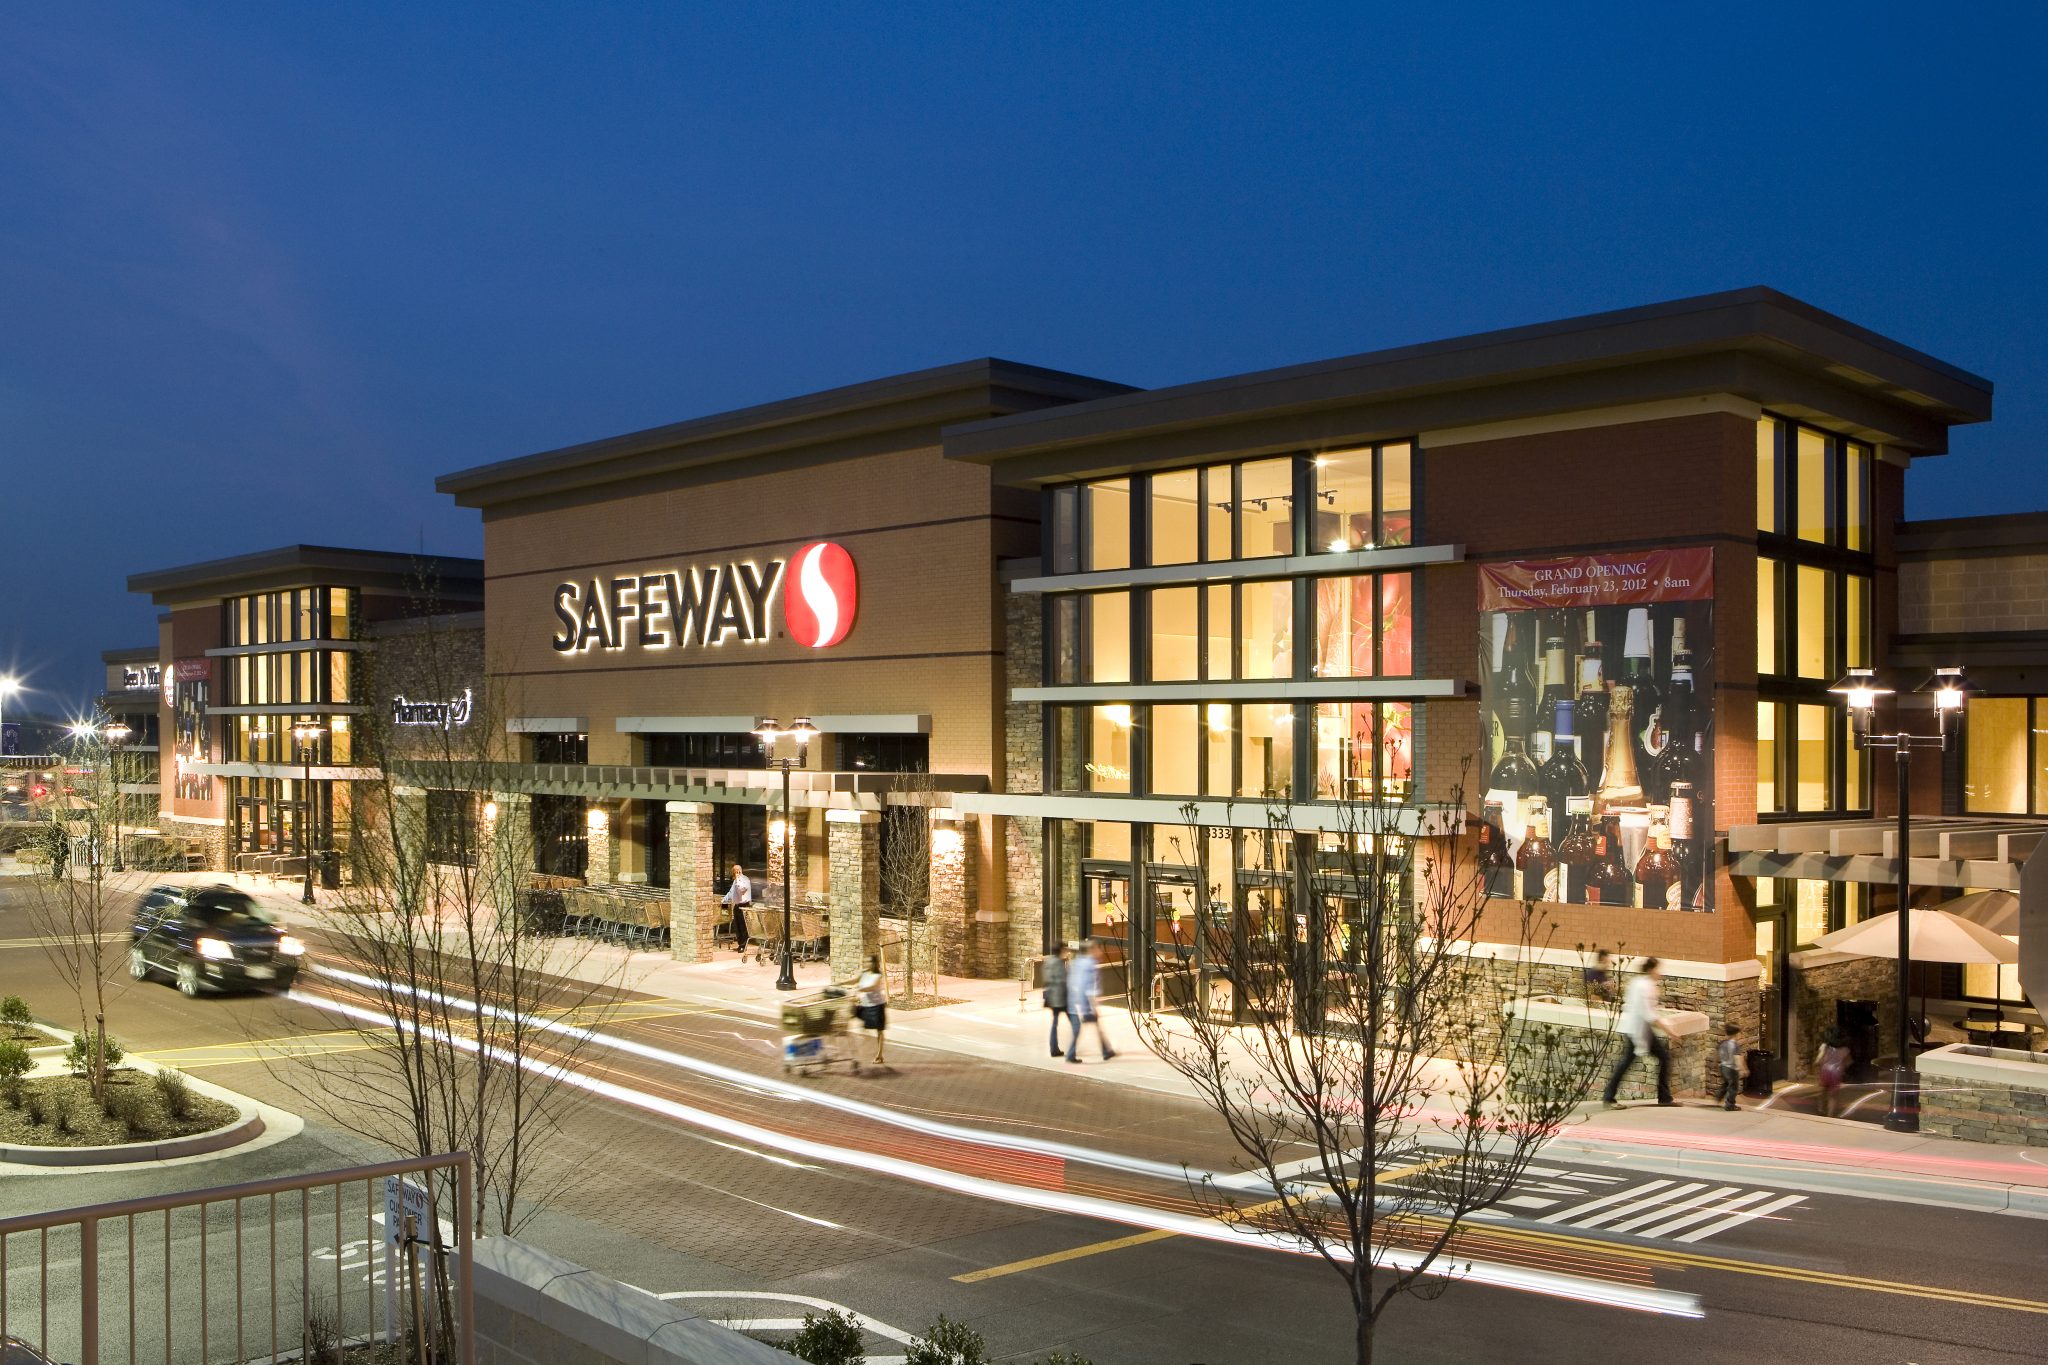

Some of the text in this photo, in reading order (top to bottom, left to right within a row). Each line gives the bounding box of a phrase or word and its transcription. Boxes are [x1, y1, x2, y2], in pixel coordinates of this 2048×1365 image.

[1534, 562, 1647, 582] GRAND OPENING
[1498, 576, 1690, 600] Thursday, February 23, 2012 8am
[552, 560, 785, 654] SAFEWAY
[1205, 827, 1231, 840] 3333
[387, 1179, 416, 1205] SAFWAY
